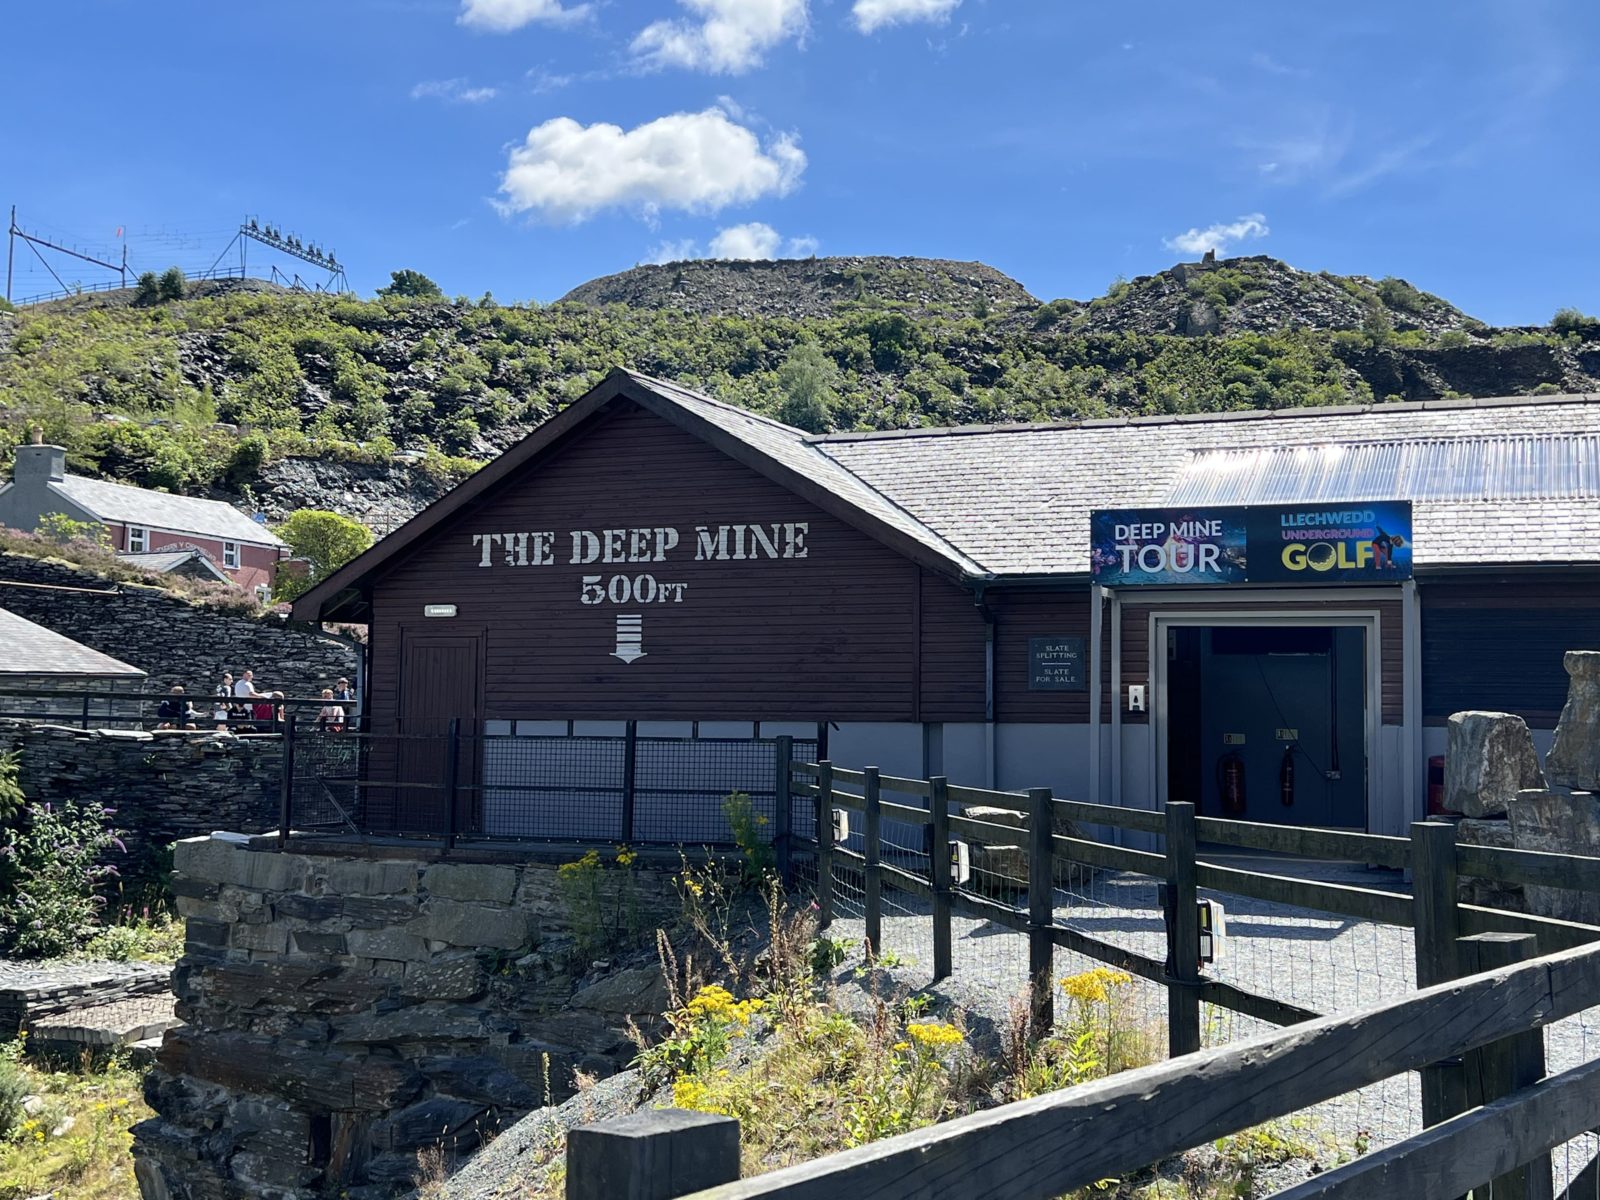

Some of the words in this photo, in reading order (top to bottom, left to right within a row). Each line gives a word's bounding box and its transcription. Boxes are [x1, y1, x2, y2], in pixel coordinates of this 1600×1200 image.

[1115, 523, 1165, 540] DEEP
[1170, 520, 1223, 537] MINE
[1281, 510, 1376, 527] LLECHWEDD
[473, 532, 555, 567] THE
[569, 527, 680, 564] DEEP
[694, 522, 809, 561] MINE
[1281, 528, 1375, 540] UNDERGROUND
[1115, 543, 1223, 574] TOUR
[1281, 541, 1374, 572] GOLF
[580, 574, 688, 604] 500FT
